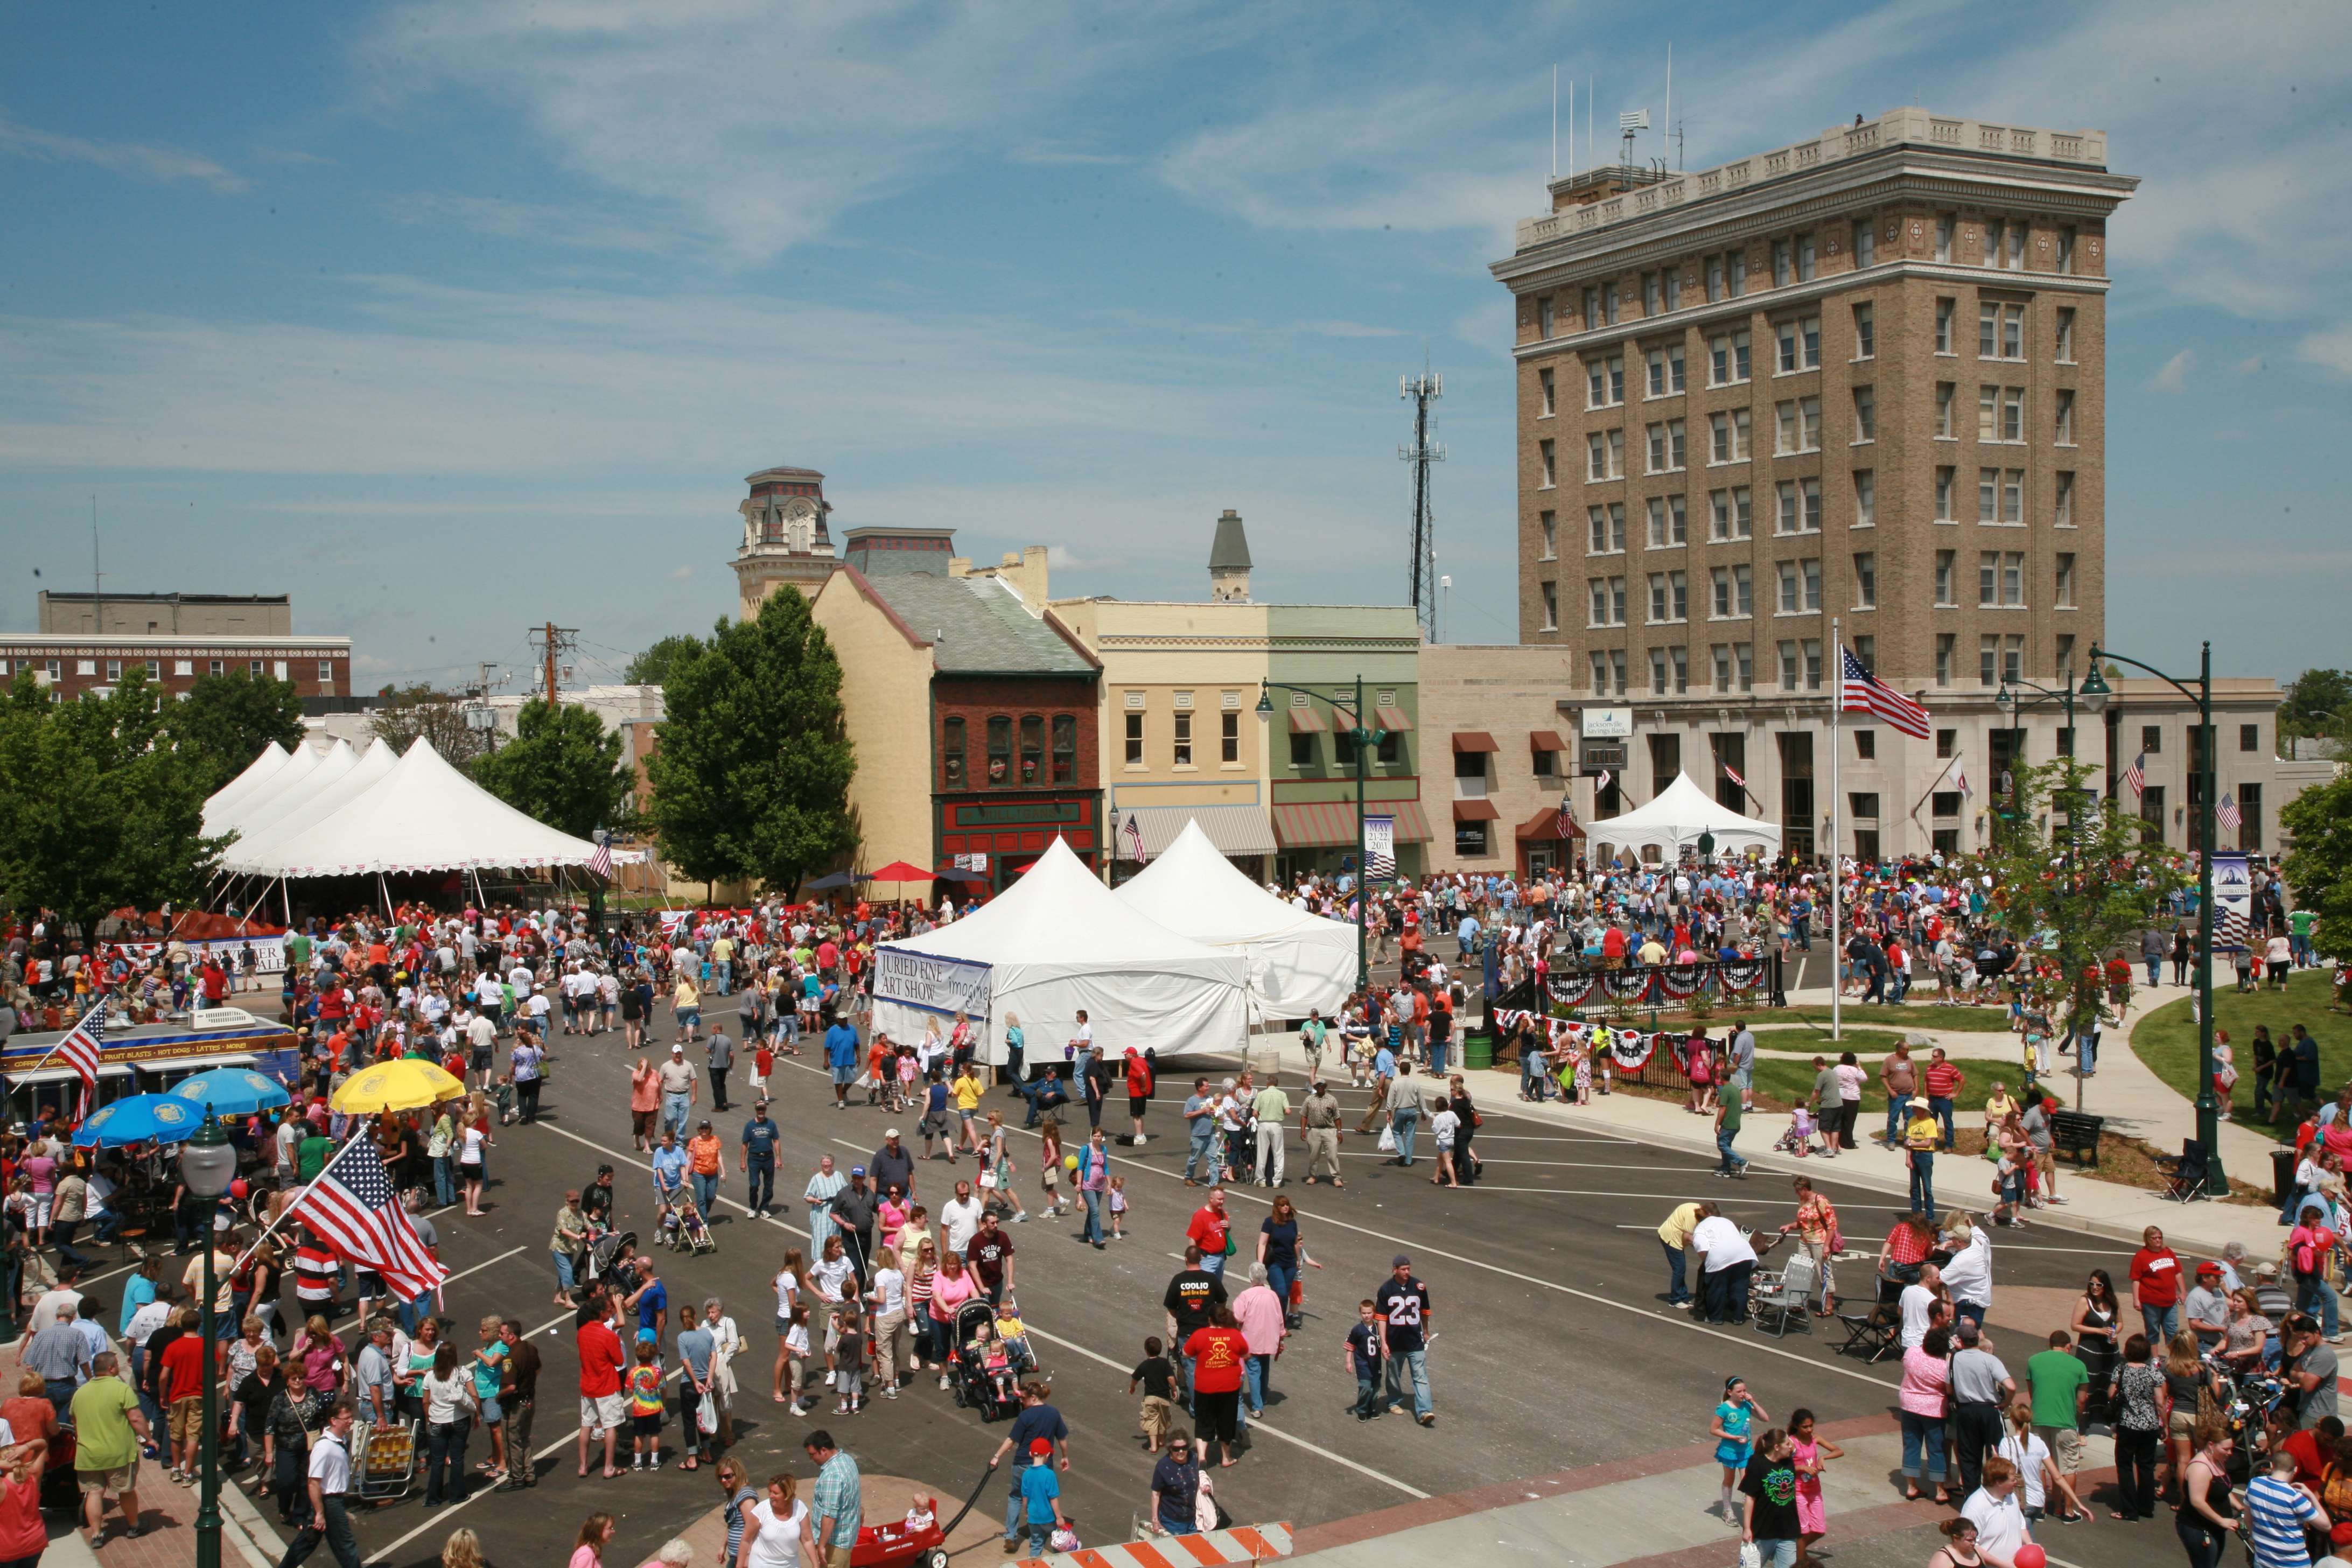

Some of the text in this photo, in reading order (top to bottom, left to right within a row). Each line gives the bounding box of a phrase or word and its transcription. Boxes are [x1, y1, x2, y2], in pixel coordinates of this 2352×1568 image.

[1370, 823, 1388, 832] MAY
[1368, 832, 1390, 842] 21-22,
[1371, 842, 1388, 850] 2011
[233, 940, 272, 948] RENWNED
[881, 955, 942, 983] JURIED FINE
[881, 977, 935, 1002] ART SHOW
[949, 976, 989, 1009] imagine
[127, 1051, 152, 1059] BLASTS
[2339, 1223, 2348, 1237] 5
[1388, 1296, 1420, 1325] 23
[1367, 1336, 1376, 1356] 6
